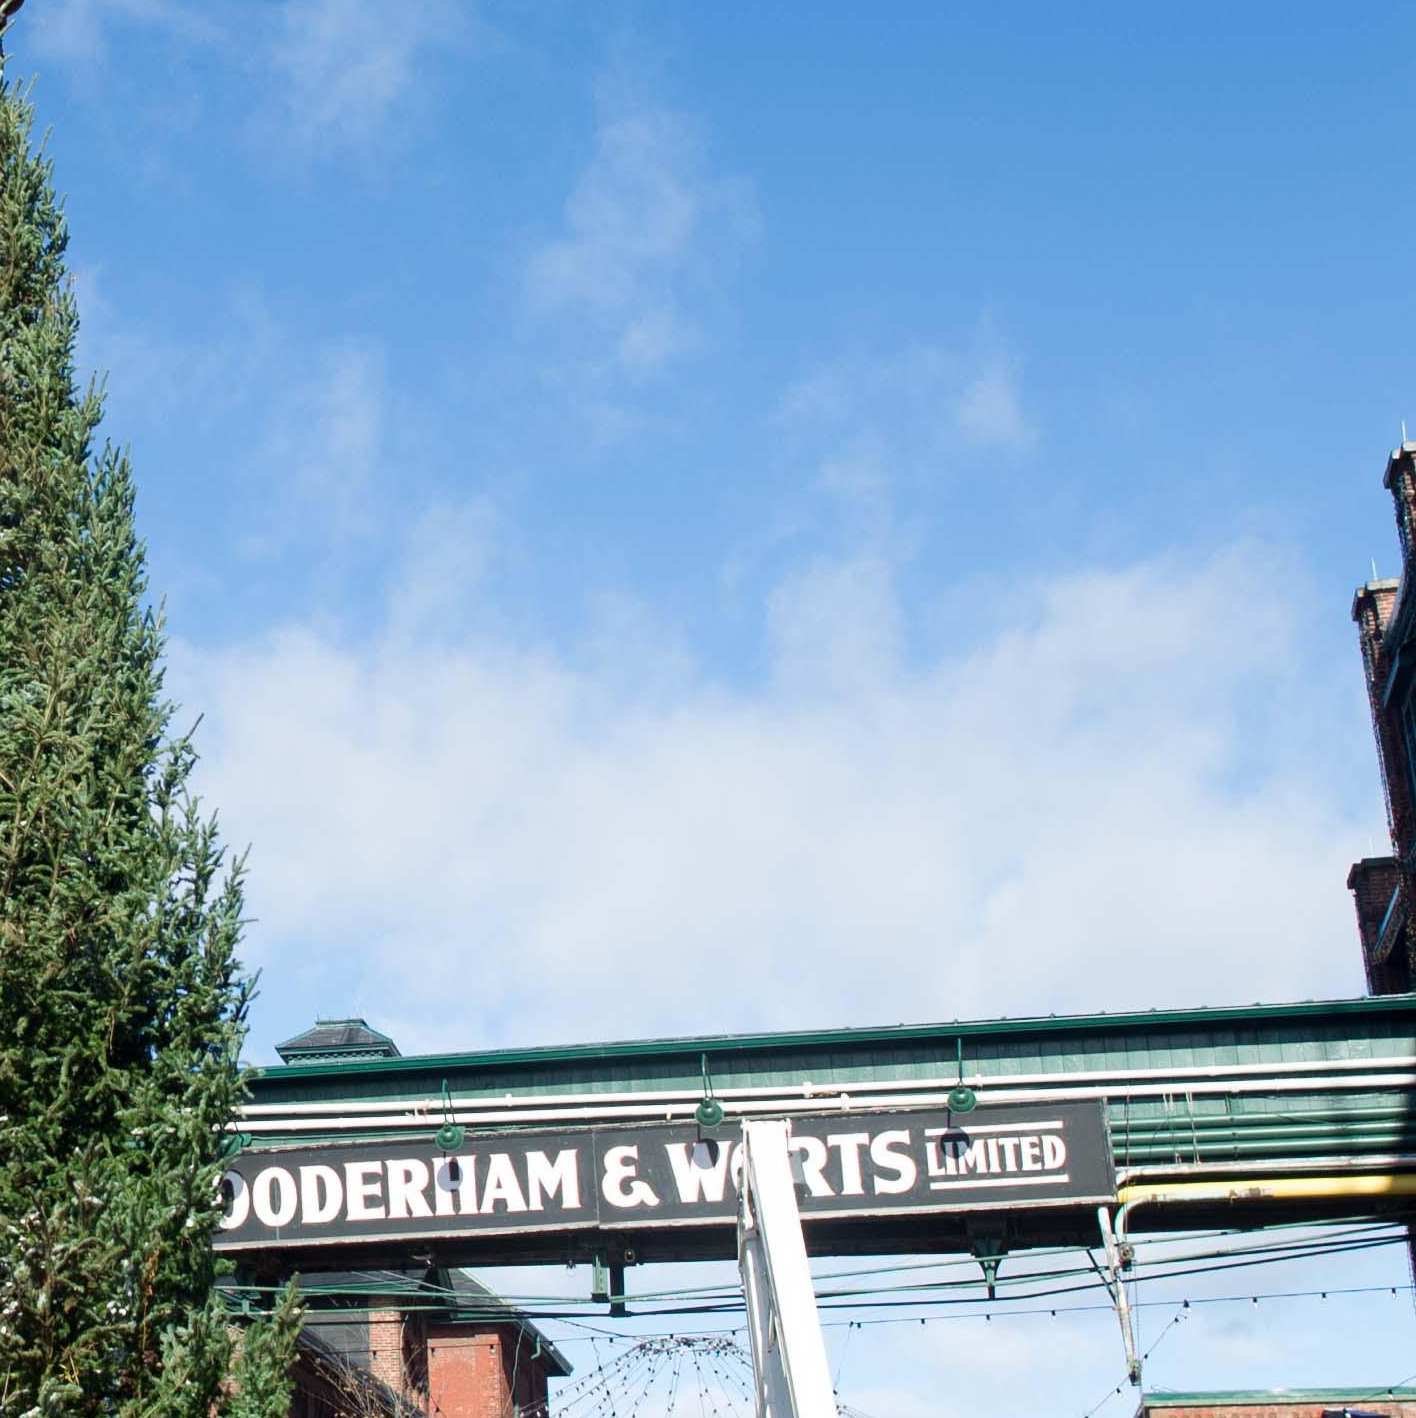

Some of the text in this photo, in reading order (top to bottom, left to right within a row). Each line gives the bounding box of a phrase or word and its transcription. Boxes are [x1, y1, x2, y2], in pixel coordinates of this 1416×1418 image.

[219, 1129, 1067, 1230] OODERHAM & WRTS LIMITED
